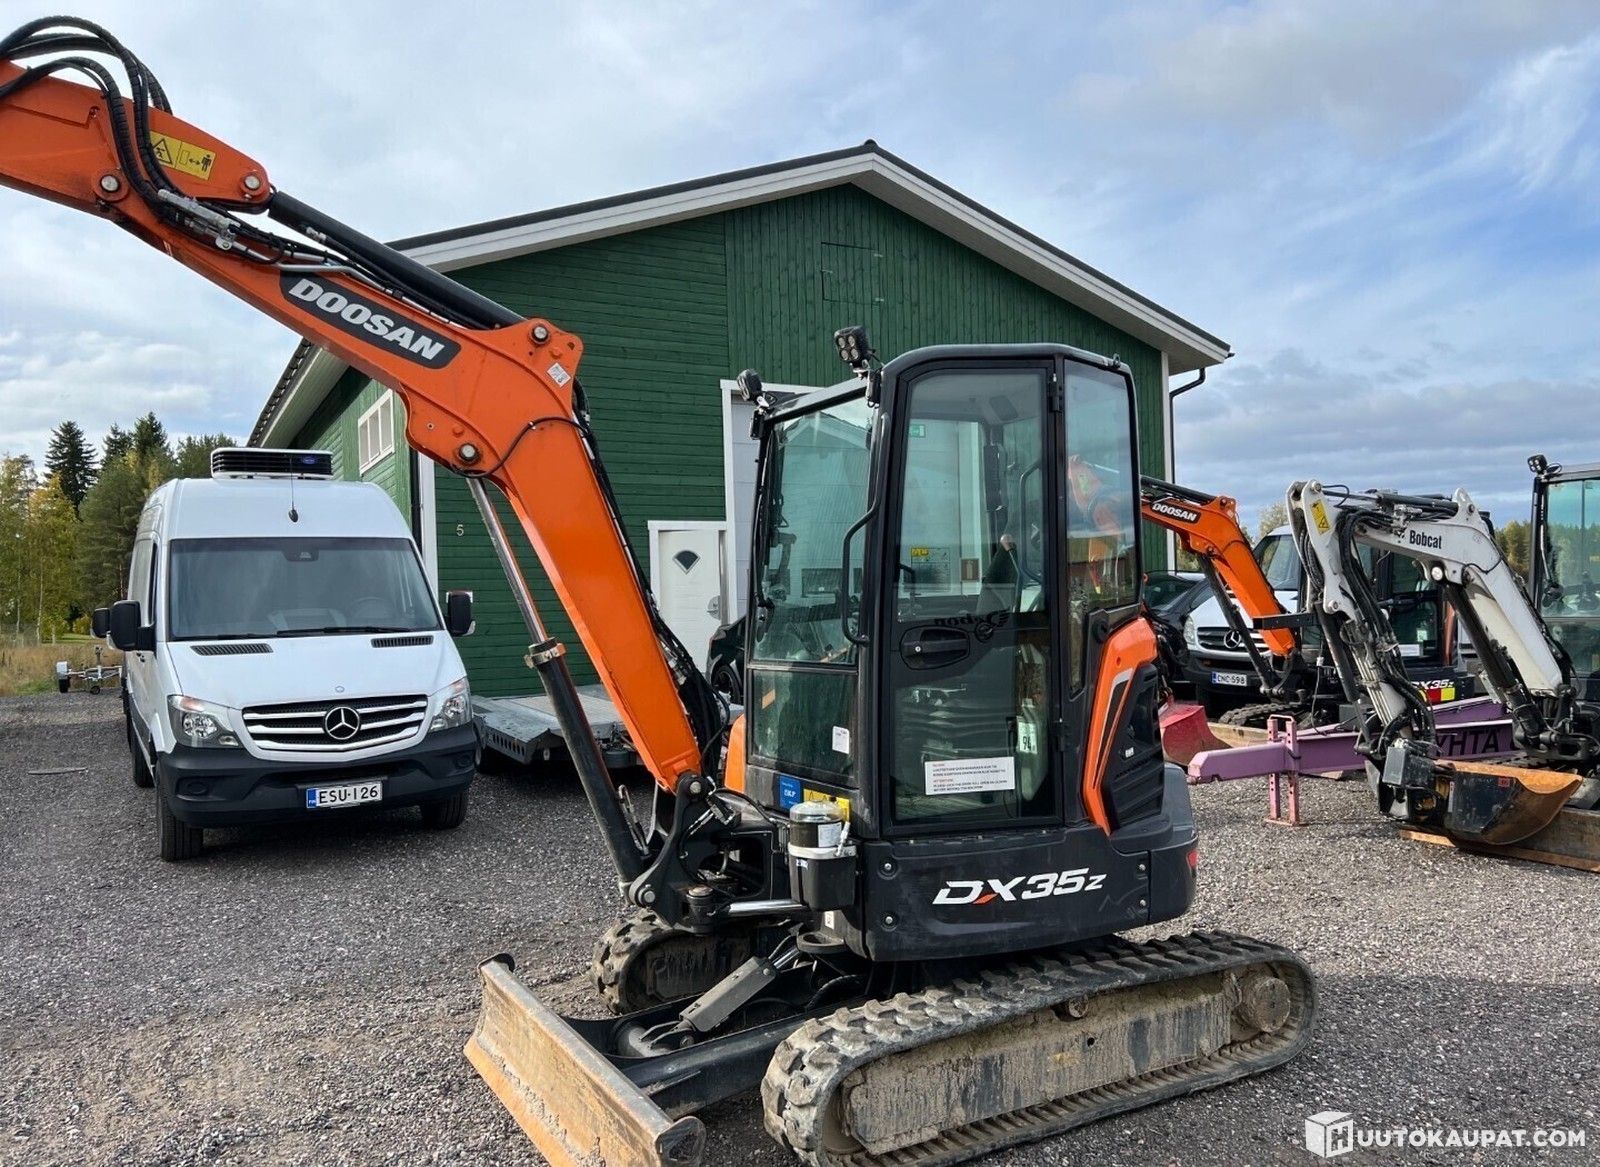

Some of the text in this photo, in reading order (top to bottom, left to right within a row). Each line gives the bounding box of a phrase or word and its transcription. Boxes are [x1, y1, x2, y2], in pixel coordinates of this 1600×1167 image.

[288, 278, 446, 361] DOOSAN
[1152, 503, 1197, 521] DOOSAN
[456, 524, 464, 536] 5
[1409, 530, 1442, 550] Bobcat
[319, 786, 379, 804] ESU-126
